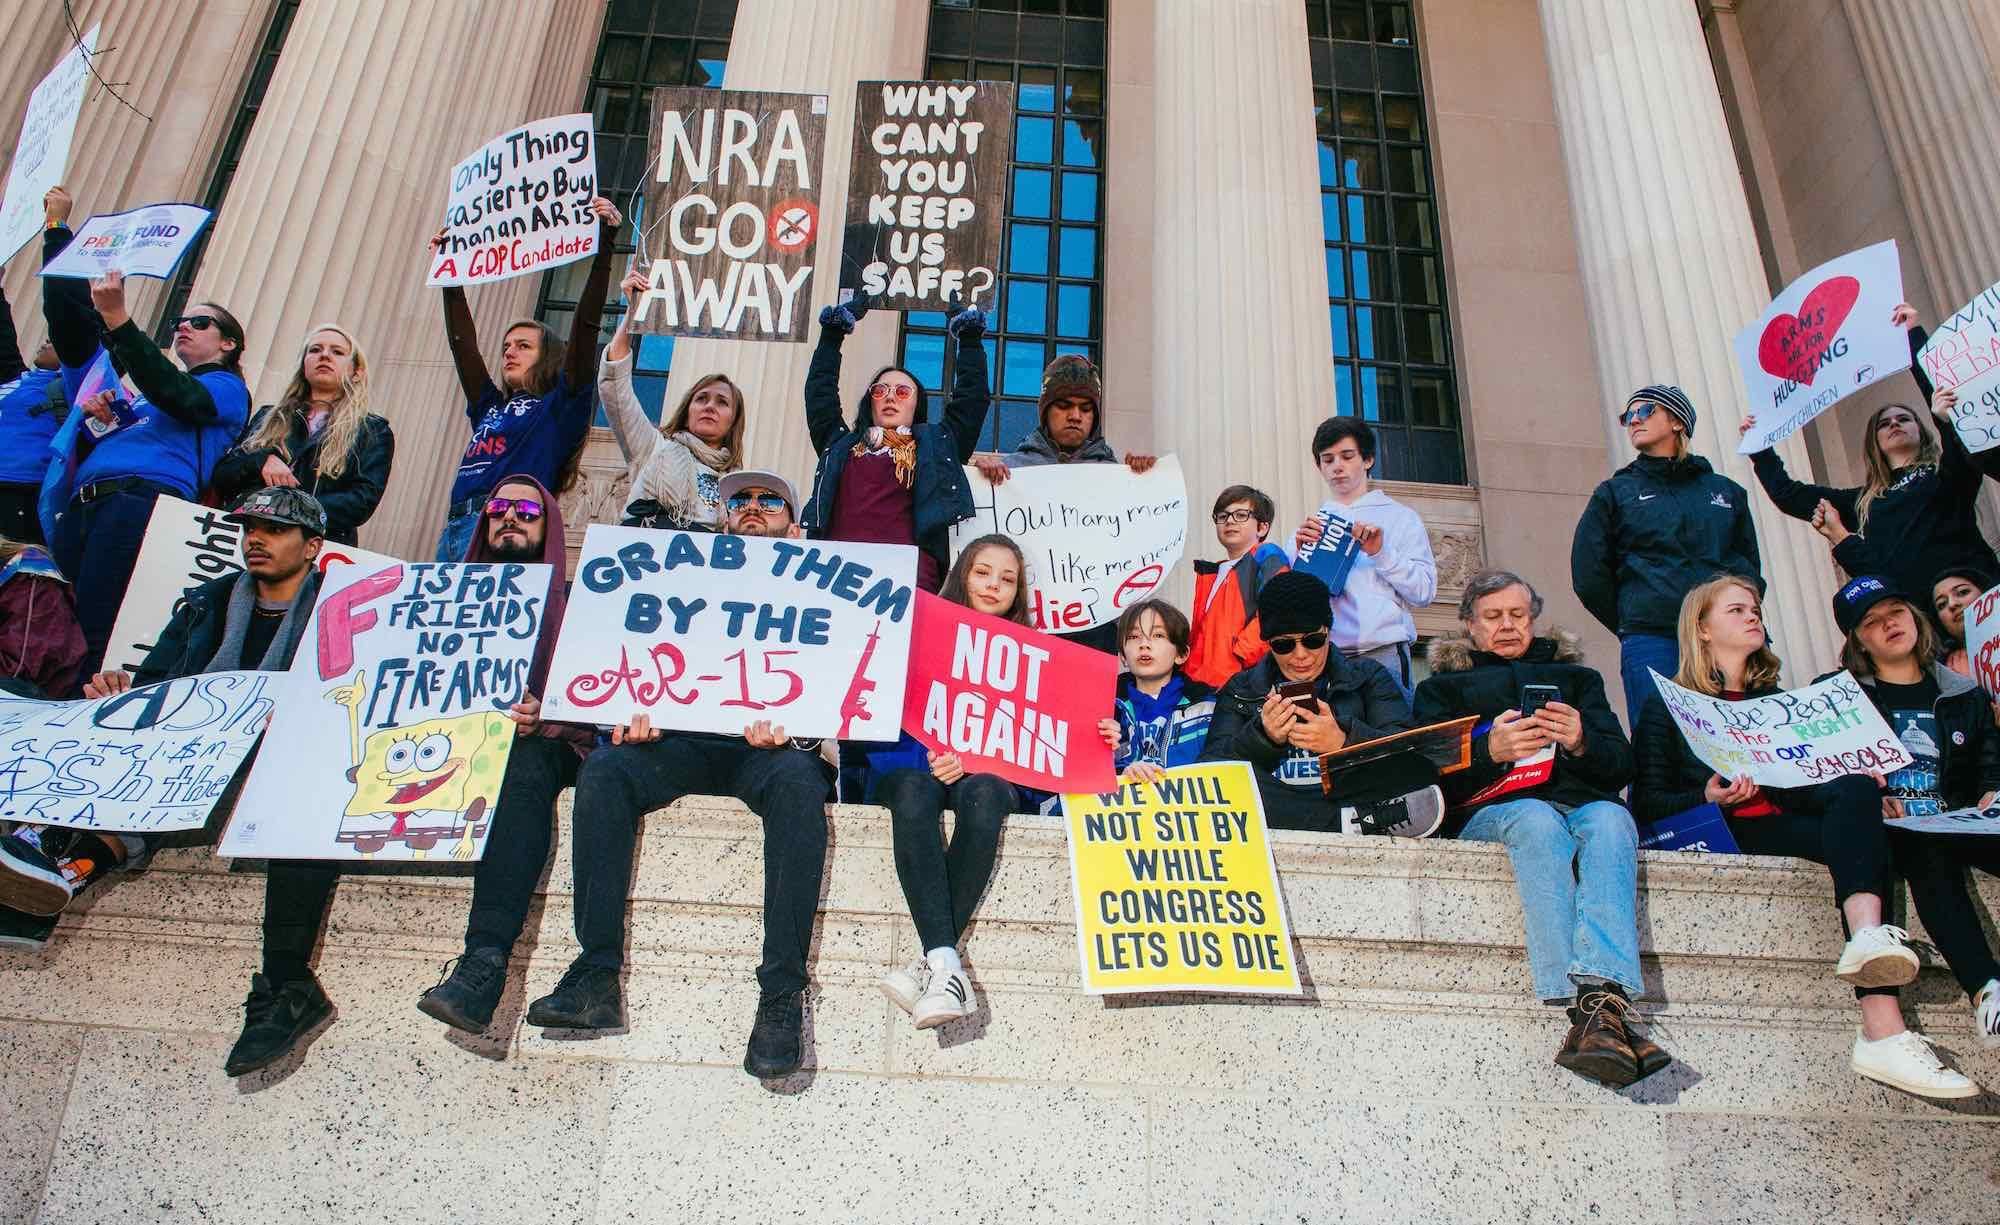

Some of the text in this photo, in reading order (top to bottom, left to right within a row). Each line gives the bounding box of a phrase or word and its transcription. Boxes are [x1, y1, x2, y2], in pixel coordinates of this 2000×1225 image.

[882, 85, 976, 118] WHY
[505, 129, 589, 169] Thing
[655, 108, 811, 190] NRA
[871, 117, 985, 156] CAN'T
[518, 176, 549, 205] to
[553, 166, 594, 206] Buy
[880, 159, 966, 195] YOU
[133, 224, 181, 240] FUND
[531, 201, 569, 233] AR
[571, 203, 596, 225] is
[668, 193, 767, 260] GO
[868, 193, 976, 230] KEEP
[433, 258, 457, 279] A
[510, 235, 594, 272] Candidate
[889, 231, 946, 266] US
[633, 258, 814, 334] AWAY
[862, 261, 995, 311] SAFE?
[1781, 306, 1825, 352] ARMS
[1773, 337, 1849, 409] HUGGING
[581, 533, 912, 623] GRAB THEM
[317, 563, 525, 682] F IS FOR
[389, 597, 540, 640] FRIENDS
[624, 593, 832, 645] BY THE
[416, 630, 498, 656] NOT
[951, 622, 1050, 704] NOT
[363, 657, 529, 729] FIREARMS
[565, 642, 804, 711] AR-15
[922, 680, 1069, 778] AGAIN
[1791, 707, 1864, 741] RIGHT
[1776, 743, 1814, 761] our
[1795, 738, 1905, 781] SCHOOLS
[1097, 776, 1231, 807] WE WILL
[1084, 811, 1248, 843] NOT SIT BY
[1126, 848, 1228, 882] WHILE
[1099, 889, 1266, 925] CONGRESS
[1096, 931, 1285, 971] LETS US DIE
